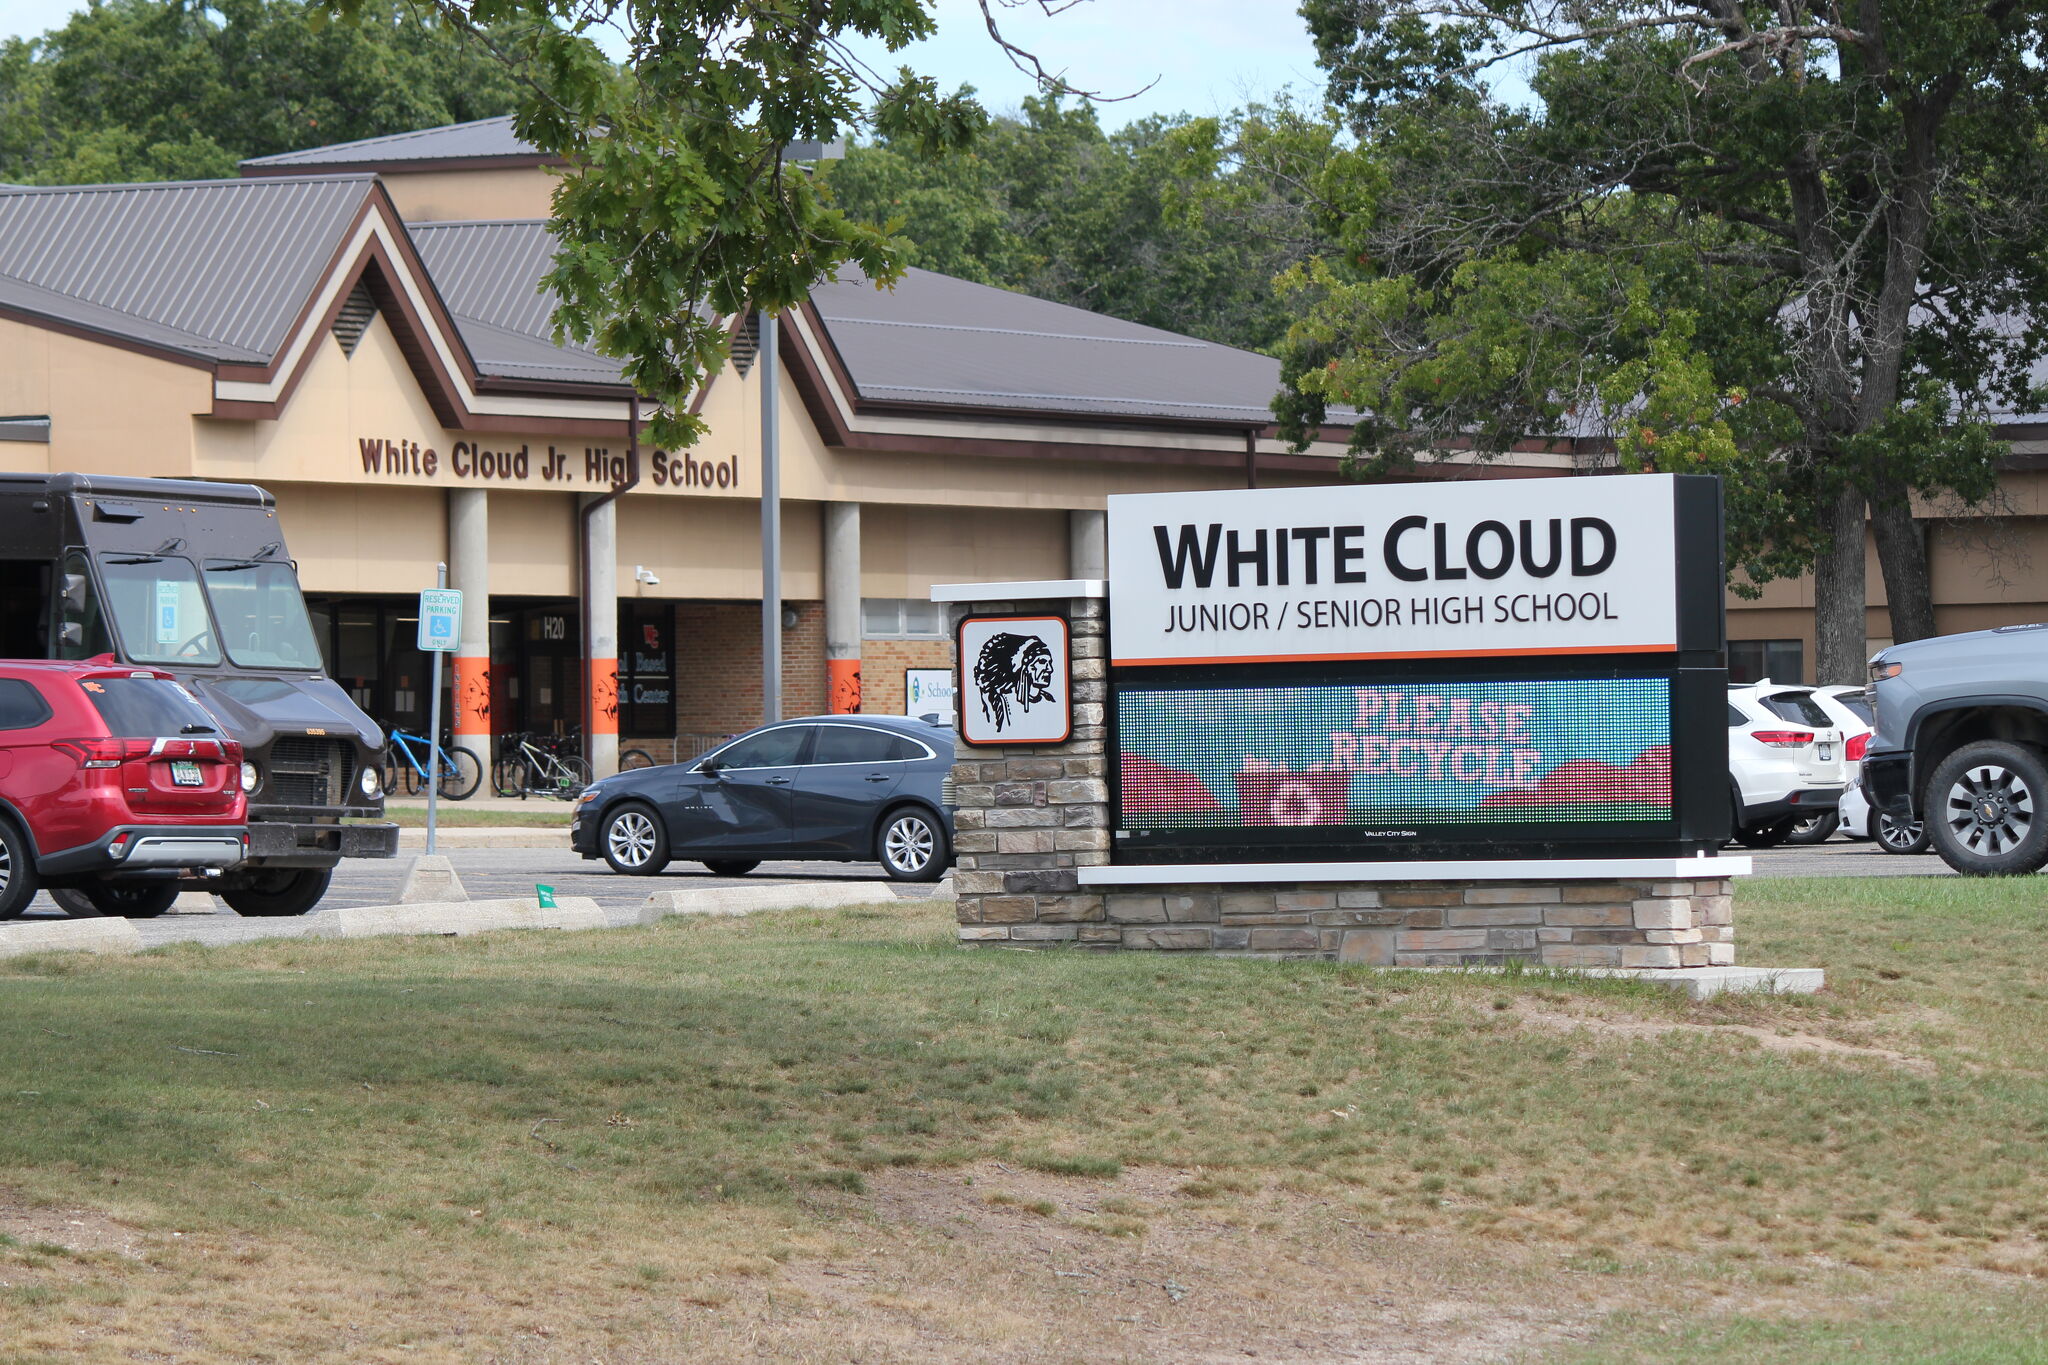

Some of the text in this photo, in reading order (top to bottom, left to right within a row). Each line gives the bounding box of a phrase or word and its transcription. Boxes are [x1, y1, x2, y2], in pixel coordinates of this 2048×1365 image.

[359, 437, 438, 476] White
[452, 441, 529, 478] Cloud
[541, 445, 573, 482] Jr.
[651, 450, 738, 488] School
[425, 595, 460, 604] RESERVED
[426, 605, 457, 615] PARKING
[1164, 602, 1269, 633] JUNIOR
[1296, 598, 1401, 630] SENIOR
[1410, 596, 1484, 625] HIGH
[1493, 592, 1618, 624] SCHOOL
[1352, 689, 1532, 744] PLEASE
[1329, 731, 1541, 791] RECYCLE
